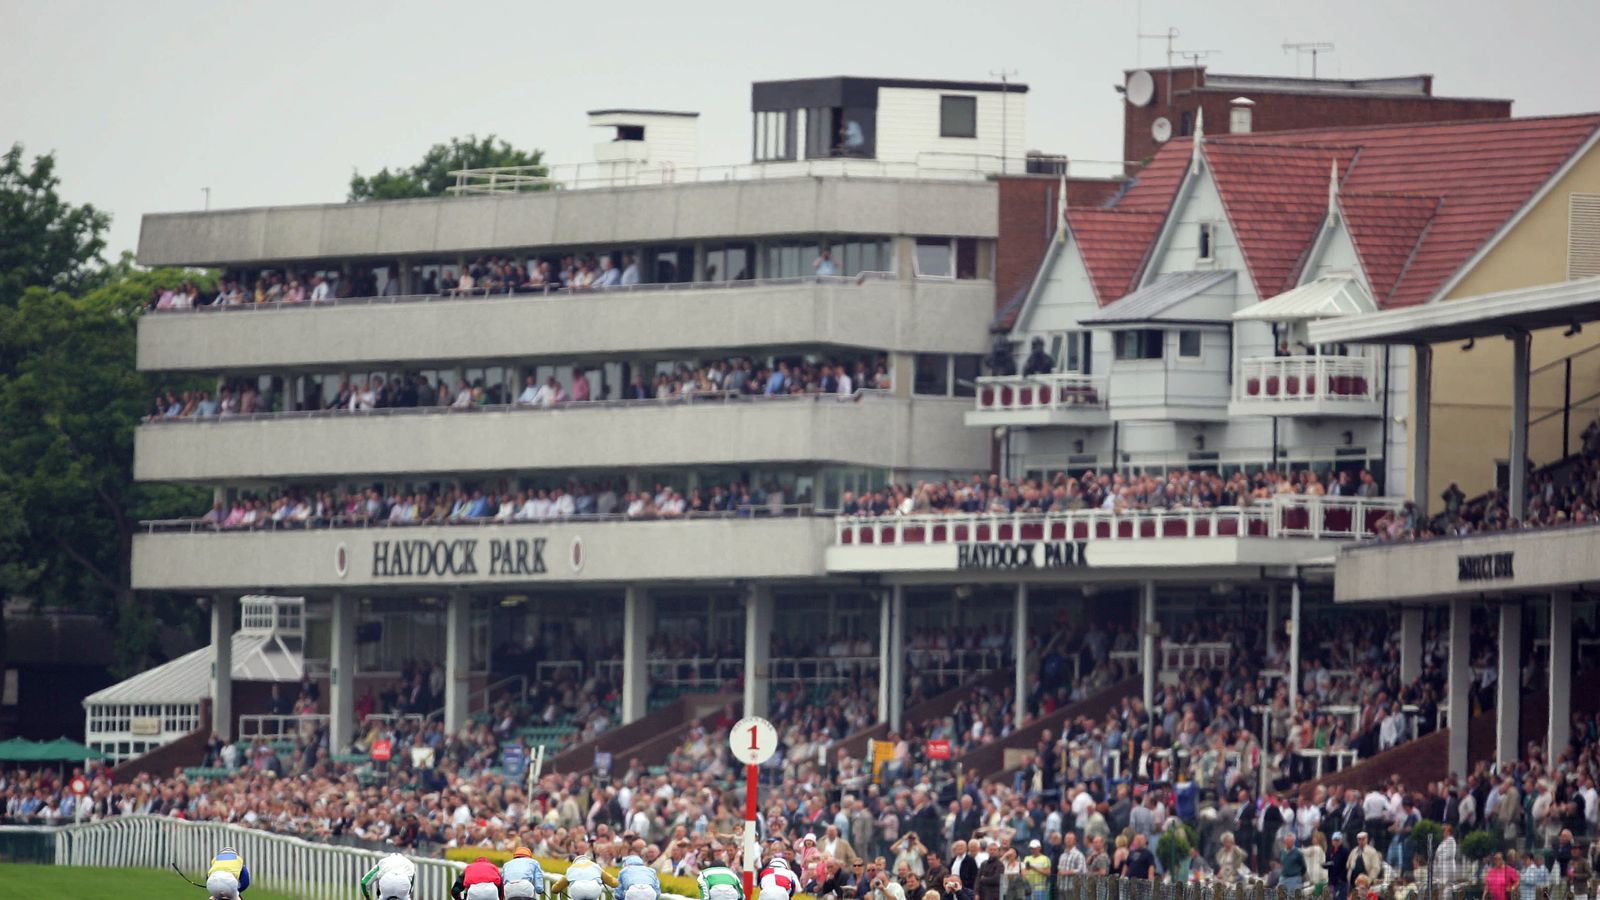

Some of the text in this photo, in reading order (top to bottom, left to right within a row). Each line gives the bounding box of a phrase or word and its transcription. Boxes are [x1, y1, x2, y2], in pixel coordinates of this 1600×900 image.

[372, 538, 547, 577] HAYDOCK PARK
[747, 725, 760, 750] 1
